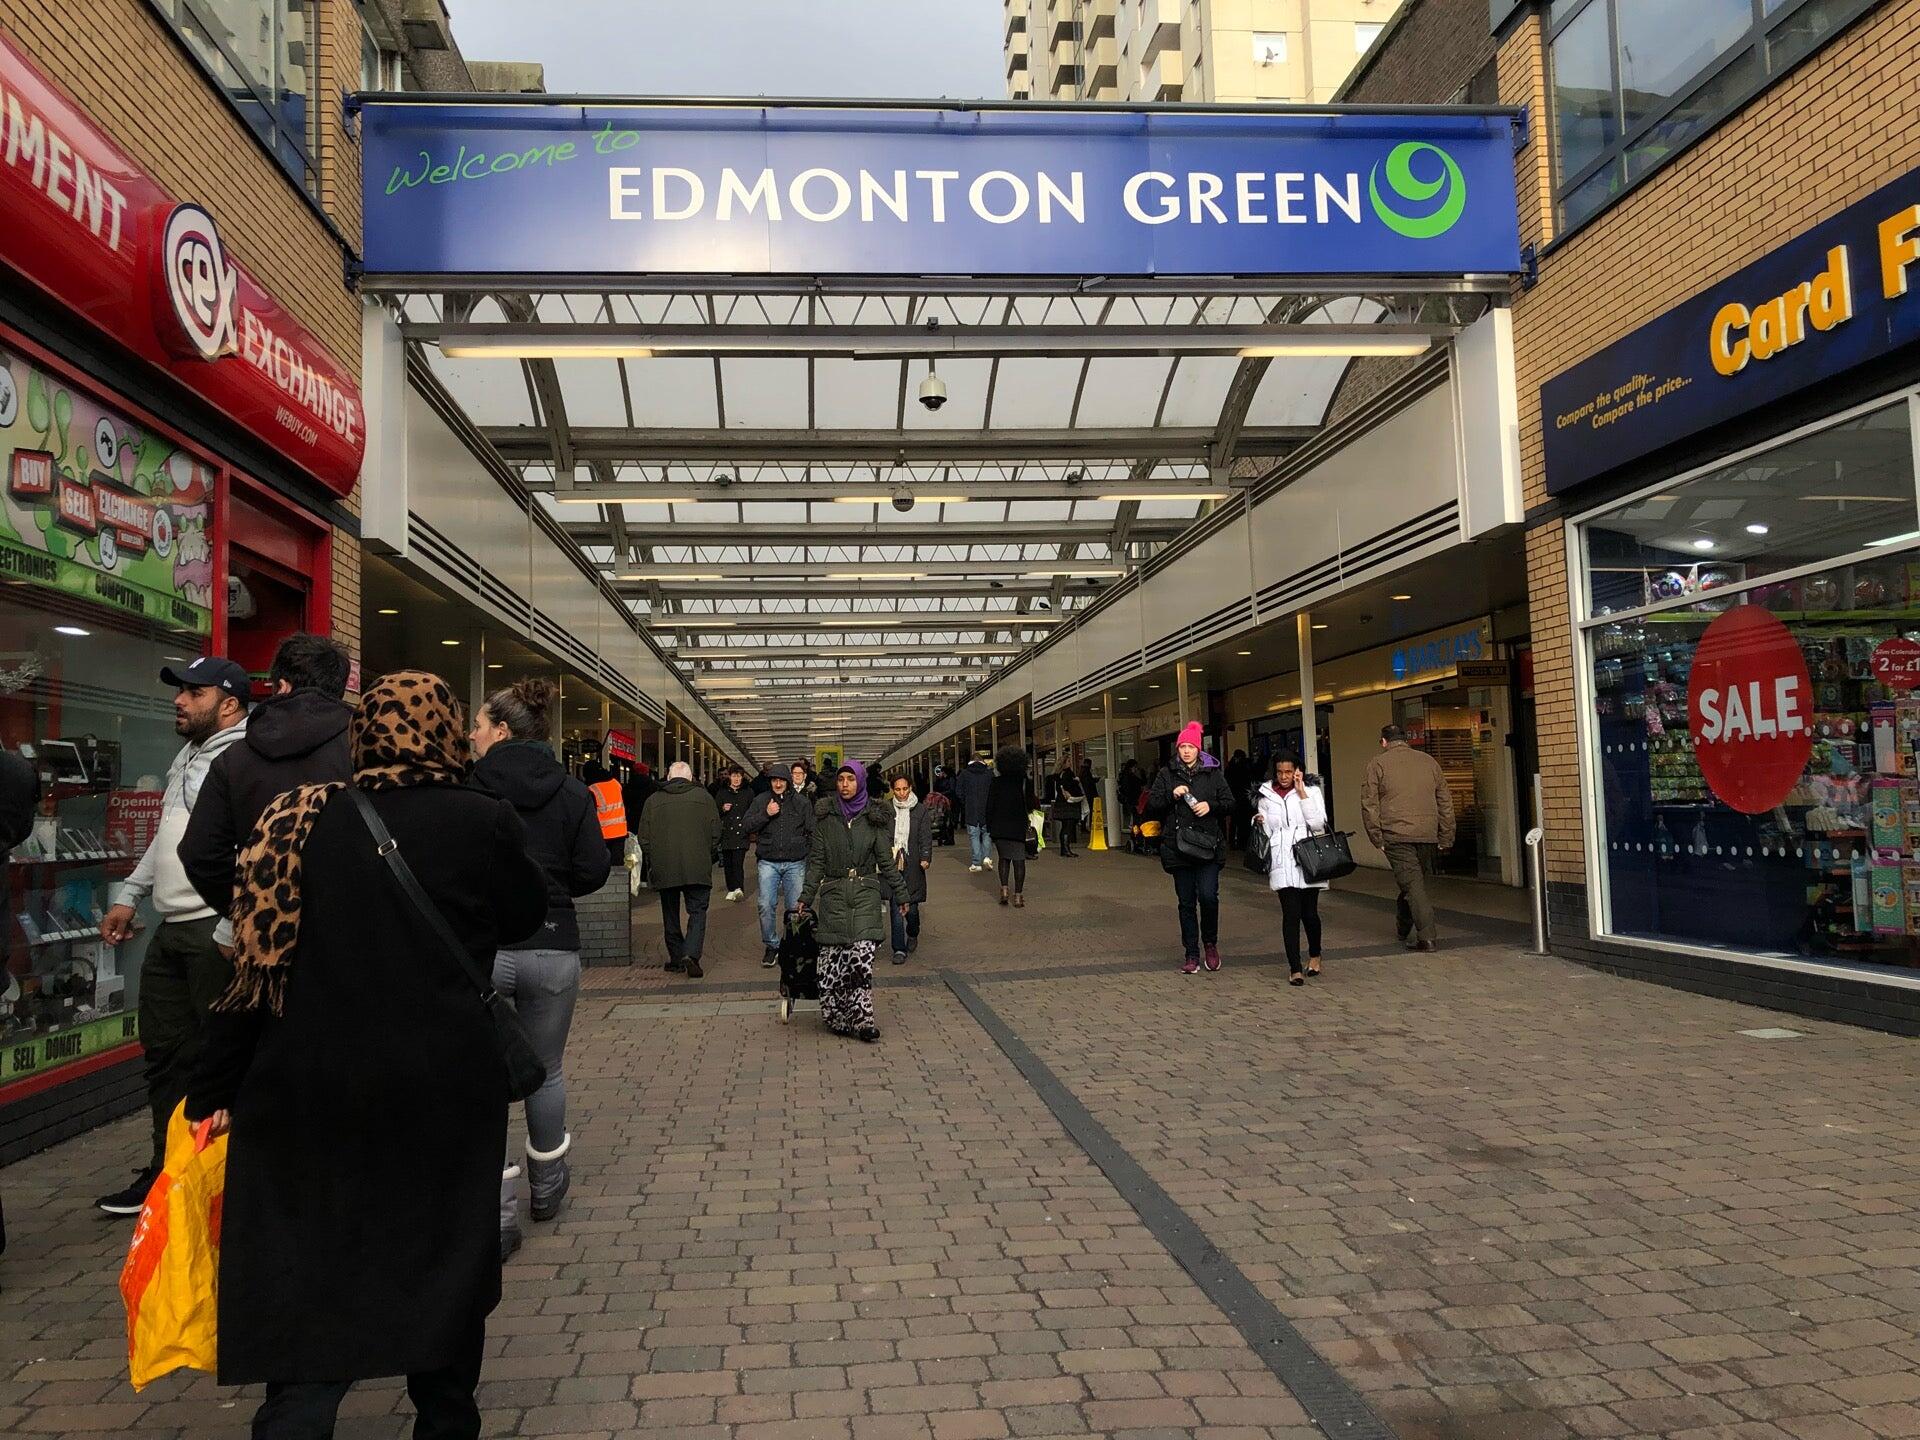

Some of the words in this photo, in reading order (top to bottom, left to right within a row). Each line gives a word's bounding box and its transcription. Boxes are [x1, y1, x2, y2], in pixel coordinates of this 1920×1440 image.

[0, 84, 127, 251] MENT
[385, 141, 579, 195] Welcome
[592, 120, 641, 154] to
[609, 166, 1086, 225] EDMONTON
[1122, 171, 1362, 225] GREEN
[1709, 244, 1854, 376] Card
[242, 305, 356, 444] EXCHANGE
[276, 405, 319, 447] WEBUY.COM
[1556, 402, 1595, 429] Compare
[1596, 392, 1612, 409] the
[1592, 400, 1634, 429] Compare
[1636, 391, 1652, 408] the
[20, 457, 45, 487] BUY
[65, 487, 91, 522] SELL
[99, 488, 148, 531] EXCHANGE
[1879, 657, 1890, 672] 2
[1891, 663, 1905, 672] for
[1699, 675, 1804, 742] SALE
[119, 809, 160, 820] Hours
[13, 1046, 37, 1072] SELL
[45, 1032, 82, 1061] DONATE
